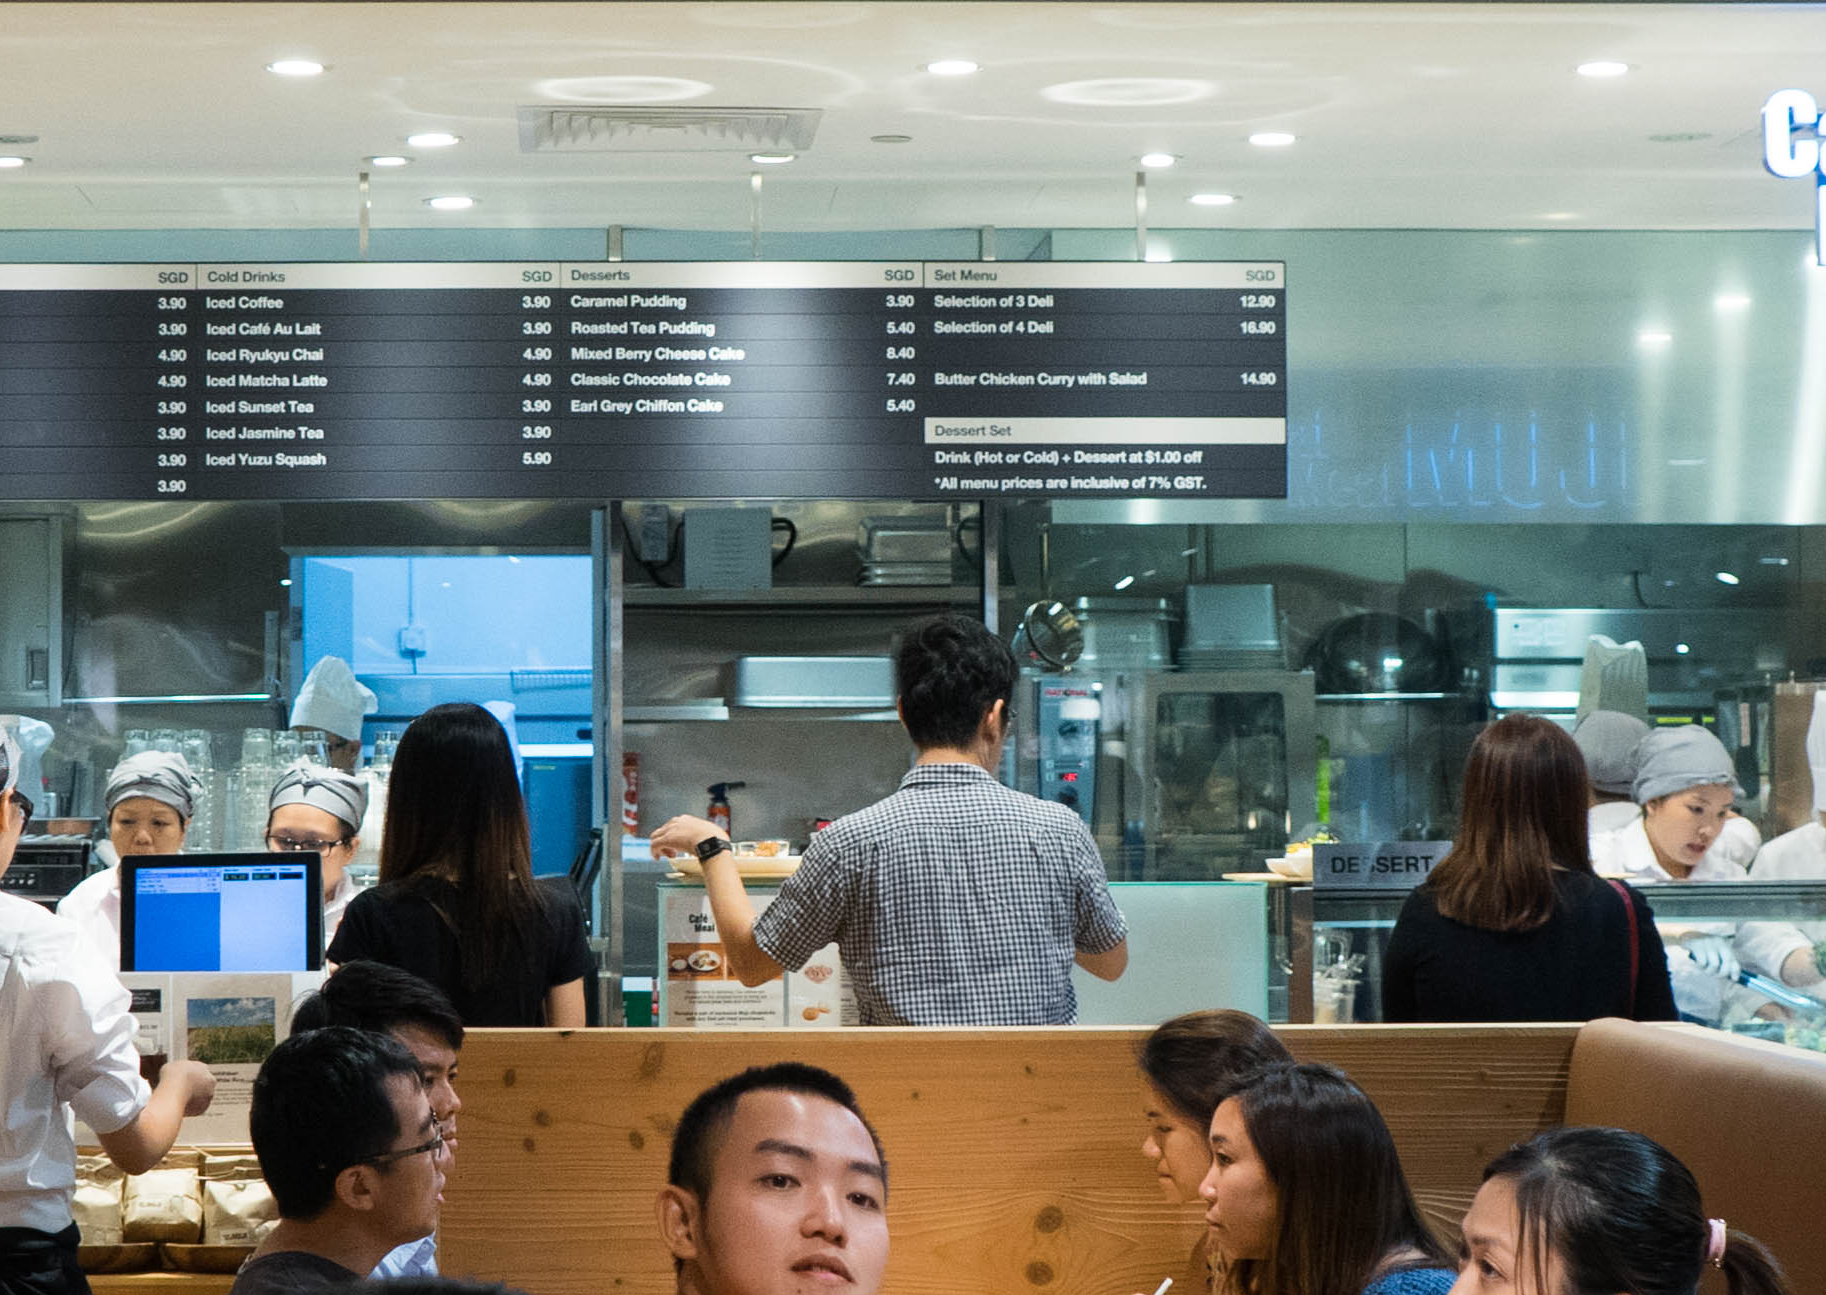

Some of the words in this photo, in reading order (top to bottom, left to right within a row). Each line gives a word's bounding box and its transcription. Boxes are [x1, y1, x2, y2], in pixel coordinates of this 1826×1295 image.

[157, 271, 189, 285] SGD
[206, 270, 239, 283] Cold
[242, 270, 286, 283] Drinks
[521, 270, 553, 283] SGD
[570, 268, 631, 282] Desserts
[933, 268, 957, 282] Set
[959, 268, 998, 282] Menu
[157, 296, 187, 310] 3.90
[205, 296, 236, 310] Iced
[237, 295, 285, 310] Coffee
[521, 295, 552, 309] 3.90
[570, 294, 629, 308] Caramel
[630, 294, 687, 311] Pudding
[885, 294, 915, 308] 3.90
[933, 294, 998, 308] Selection
[998, 294, 1015, 308] of
[1015, 294, 1026, 308] 3
[1027, 294, 1054, 308] Deli
[1239, 294, 1276, 309] 12.90
[158, 322, 188, 336] 3.90
[206, 322, 237, 336] Iced
[238, 322, 272, 336] Café
[272, 322, 293, 336] Au
[294, 322, 322, 336] Lait
[522, 321, 553, 335] 3.90
[570, 321, 629, 335] Roasted
[629, 321, 657, 335] Tea
[658, 321, 716, 338] Pudding
[886, 321, 916, 335] 5.40
[933, 320, 997, 334] Selection
[998, 320, 1015, 334] of
[1015, 320, 1026, 334] 4
[1027, 320, 1054, 334] Deli
[1240, 320, 1277, 335] 16.90
[157, 348, 188, 362] 4.90
[206, 348, 237, 362] Iced
[238, 348, 290, 364] Ryukyu
[291, 347, 324, 362] Chai
[522, 347, 553, 361] 4.90
[570, 347, 613, 361] Mixed
[614, 346, 653, 363] Berry
[654, 346, 707, 361] Cheese
[708, 346, 745, 361] Cake
[885, 346, 916, 360] 8.40
[157, 374, 187, 388] 4.90
[206, 374, 237, 387] Iced
[238, 373, 291, 387] Matcha
[292, 373, 329, 387] Latte
[522, 372, 552, 387] 4.90
[570, 372, 621, 387] Classic
[622, 372, 693, 387] Chocolate
[693, 371, 732, 386] Cake
[886, 372, 916, 386] 7.40
[934, 372, 978, 386] Butter
[978, 372, 1036, 386] Chicken
[1036, 372, 1076, 388] Curry
[1076, 372, 1107, 386] with
[1108, 371, 1148, 386] Salad
[1240, 371, 1277, 386] 14.90
[157, 401, 187, 415] 3.90
[205, 400, 236, 414] Iced
[237, 400, 286, 414] Sunset
[287, 400, 315, 414] Tea
[522, 399, 552, 413] 3.90
[570, 399, 598, 413] Earl
[599, 399, 634, 415] Grey
[634, 398, 686, 413] Chiffon
[686, 398, 724, 413] Cake
[886, 398, 916, 412] 5.40
[157, 427, 187, 441] 3.90
[205, 426, 237, 440] Iced
[237, 426, 297, 440] Jasmine
[297, 426, 325, 440] Tea
[522, 425, 552, 439] 3.90
[934, 424, 987, 437] Dessert
[988, 424, 1012, 437] Set
[157, 453, 187, 467] 3.90
[205, 452, 236, 467] Iced
[237, 452, 273, 466] Yuzu
[274, 452, 327, 469] Squash
[522, 451, 552, 465] 5.90
[934, 450, 972, 464] Drink
[973, 450, 1004, 467] (Hot
[1004, 453, 1022, 464] or
[1022, 450, 1060, 466] Cold)
[1073, 450, 1128, 464] Dessert
[1128, 450, 1144, 464] at
[1144, 449, 1182, 465] $1.00
[1182, 450, 1204, 464] off
[157, 479, 187, 493] 3.90
[959, 478, 1000, 490] menu
[1000, 475, 1044, 492] prices
[1045, 478, 1069, 489] are
[1070, 475, 1130, 490] inclusive
[1131, 475, 1147, 490] of
[1147, 475, 1172, 490] 7%
[1173, 475, 1208, 490] GST.
[1330, 856, 1433, 874] DESERT
[688, 914, 708, 924] Café
